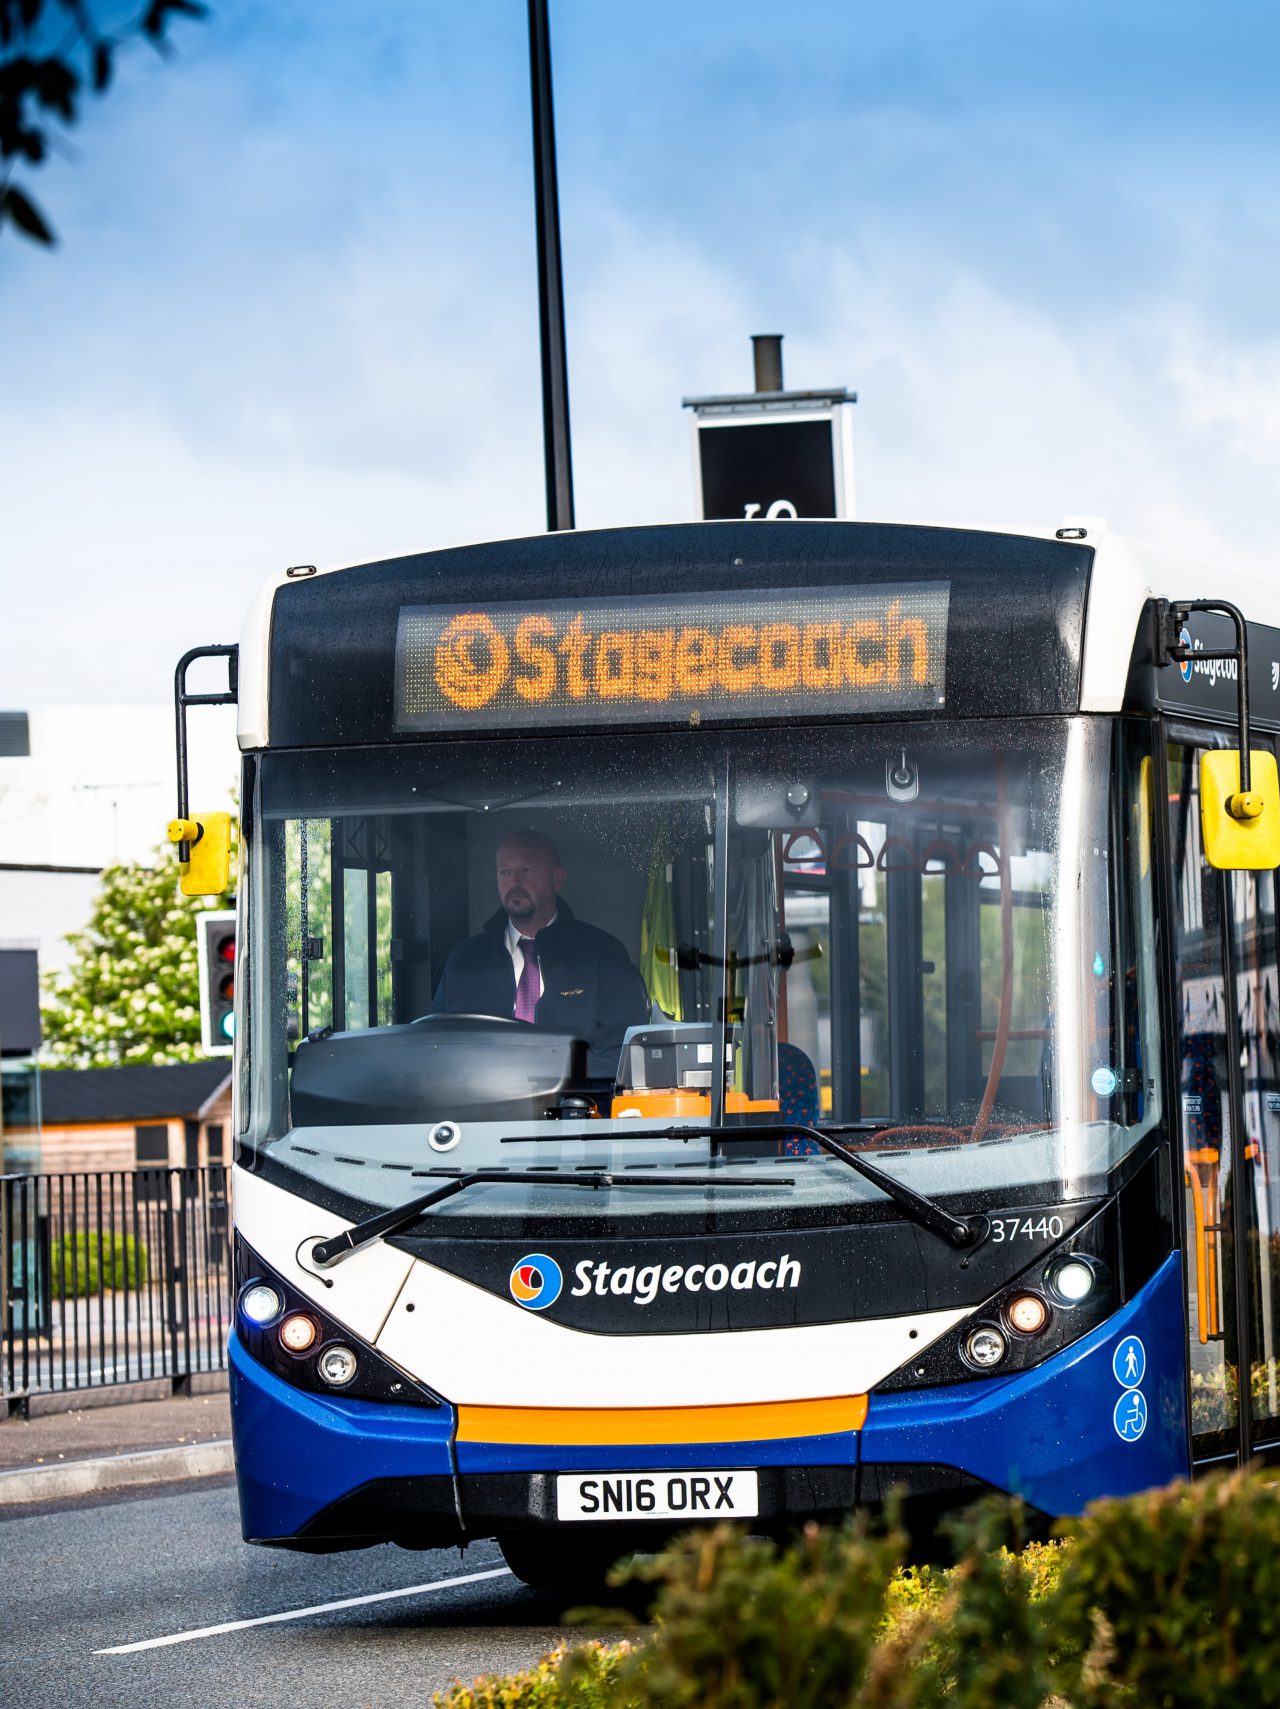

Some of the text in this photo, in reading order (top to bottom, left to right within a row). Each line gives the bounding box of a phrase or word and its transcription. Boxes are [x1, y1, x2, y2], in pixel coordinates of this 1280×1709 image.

[515, 599, 929, 702] Stagecoach
[1194, 638, 1239, 687] Stagecoa
[991, 1215, 1064, 1243] 37440
[570, 1253, 802, 1305] Stagecoach
[579, 1476, 735, 1513] SN16 ORX
